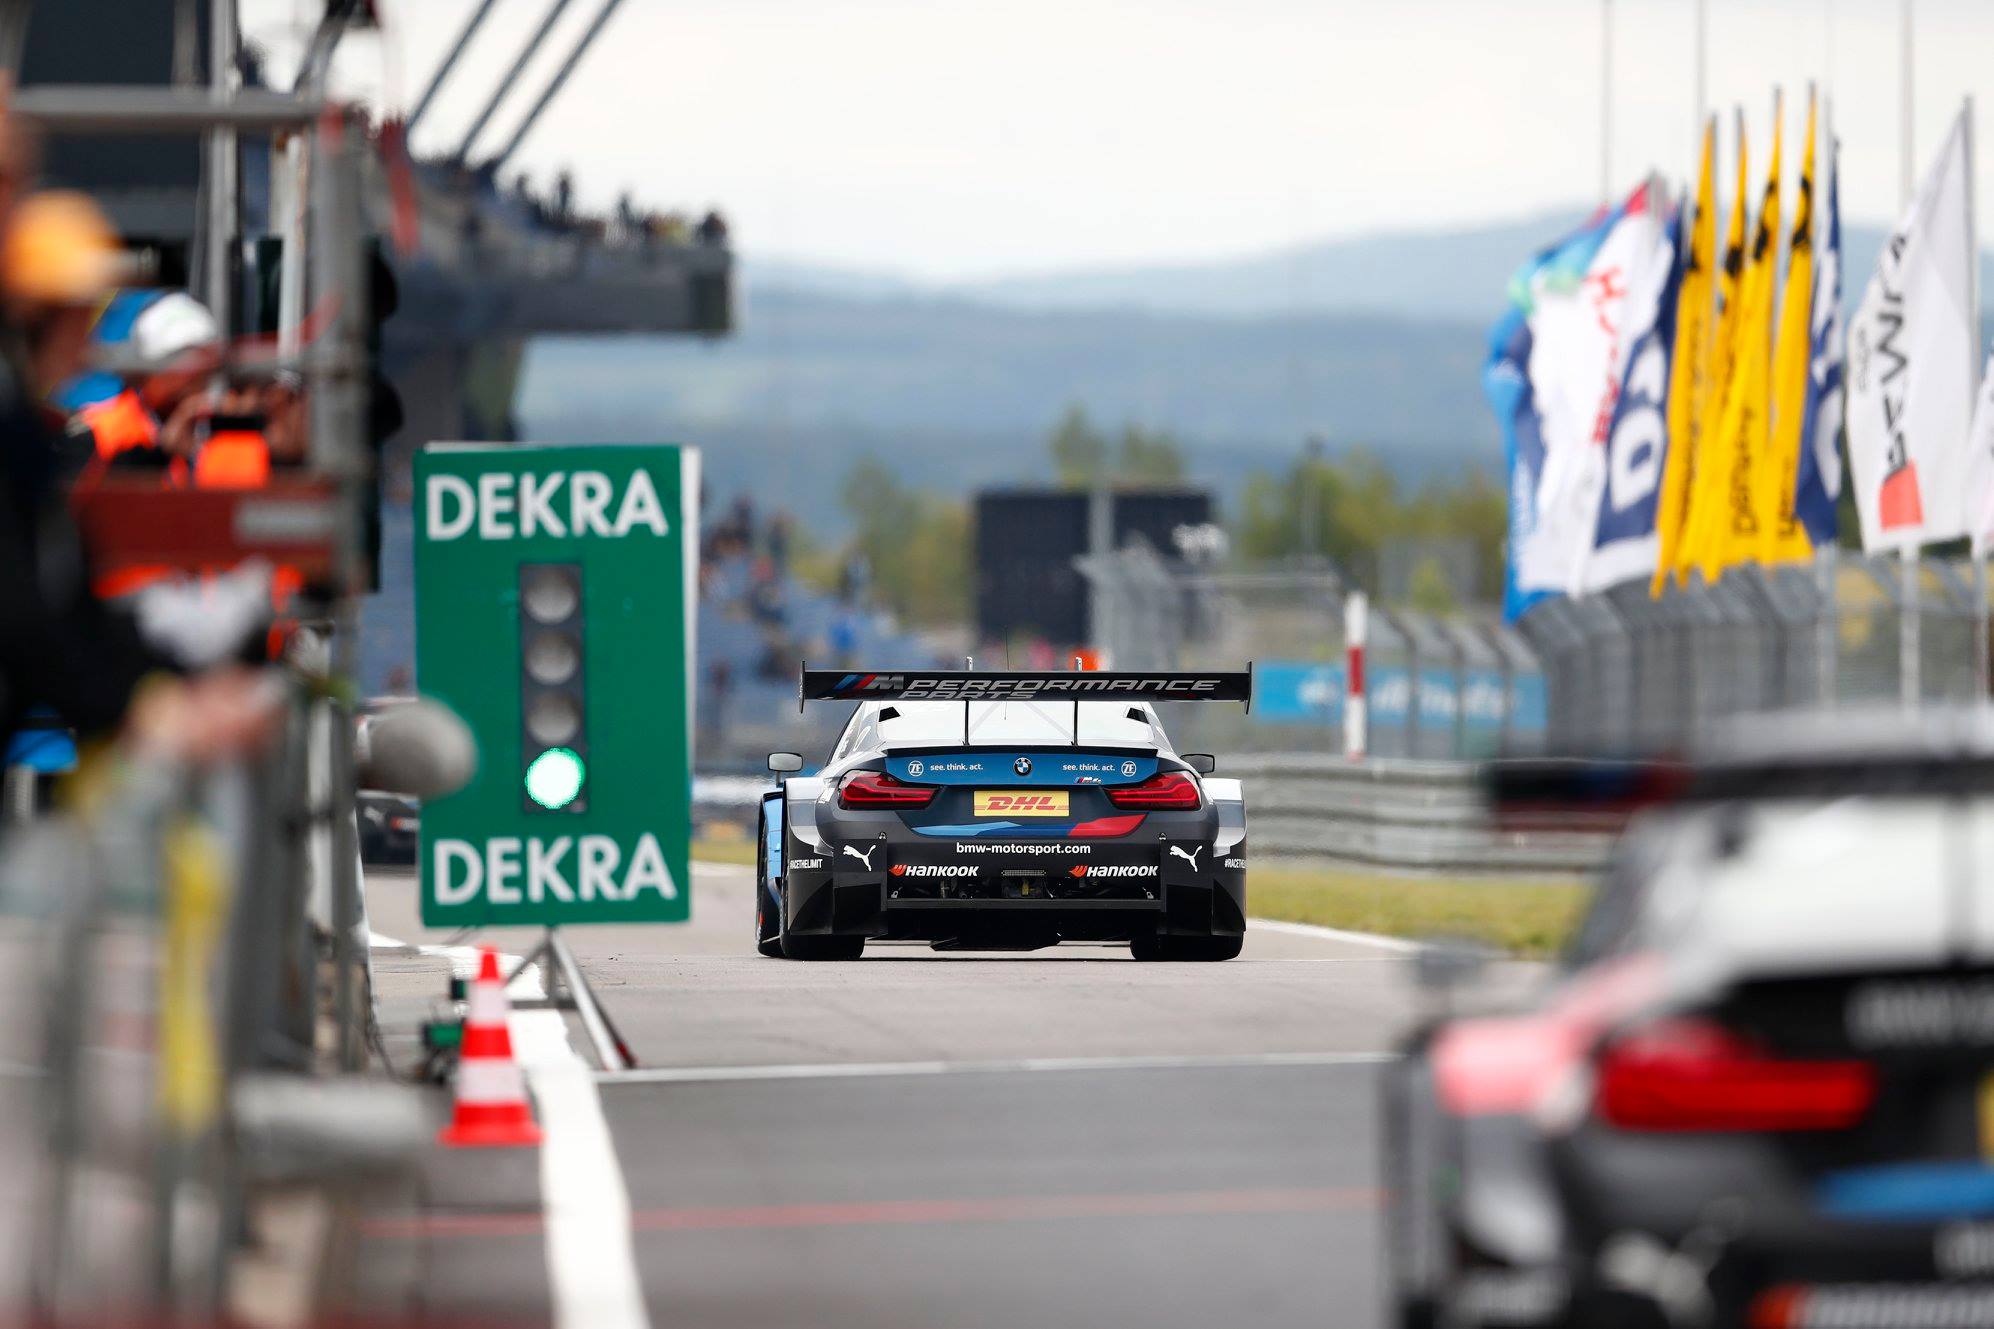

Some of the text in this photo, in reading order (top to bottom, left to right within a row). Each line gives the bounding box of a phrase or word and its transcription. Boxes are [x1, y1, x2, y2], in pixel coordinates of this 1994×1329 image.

[426, 468, 669, 541] DEKRA
[908, 679, 1221, 692] PERFORMANCE
[897, 689, 1037, 699] PARTS
[909, 762, 923, 775] ZF
[947, 762, 968, 771] think.
[969, 763, 983, 771] act.
[1079, 763, 1100, 771] think.
[1122, 762, 1136, 776] ZF
[987, 796, 1057, 811] DHL
[956, 841, 1091, 857] bmw-motorsport.com
[434, 831, 678, 905] DEKRA
